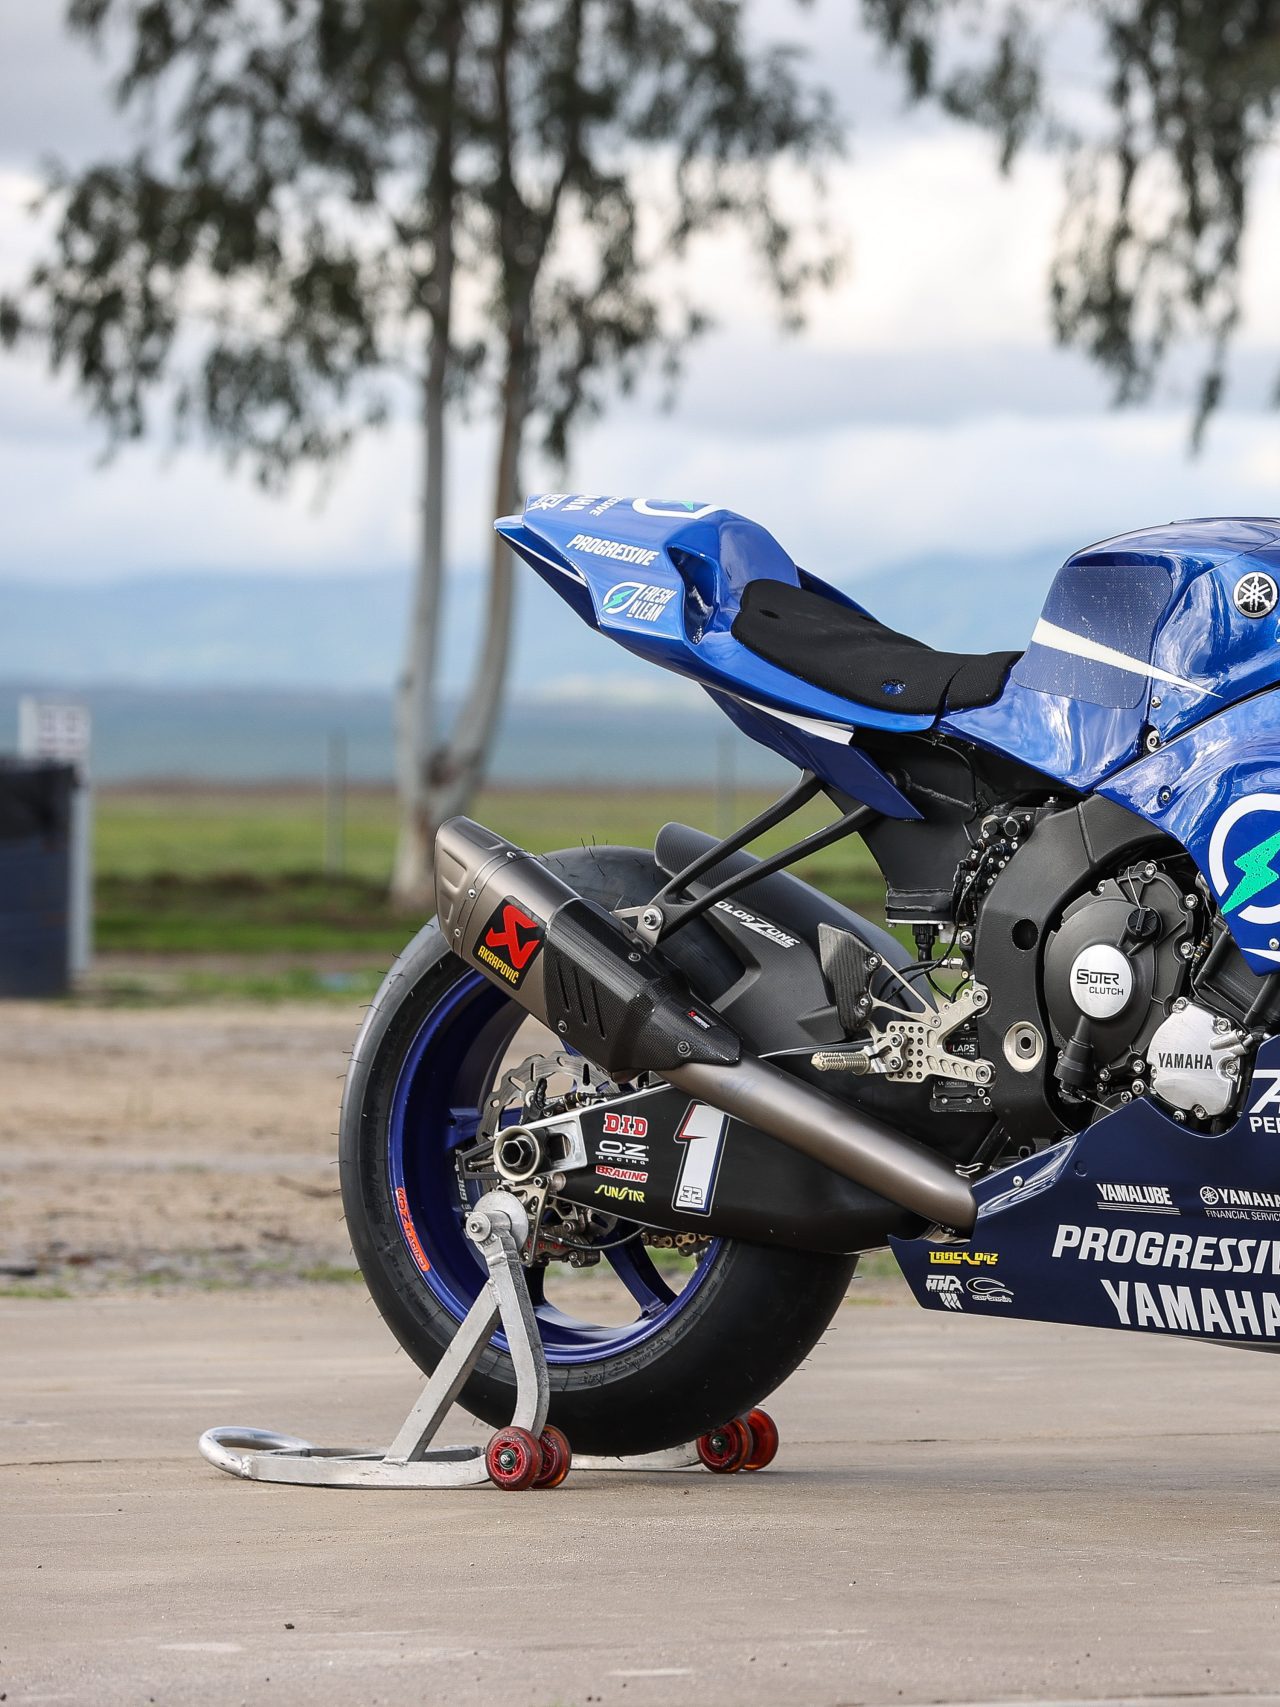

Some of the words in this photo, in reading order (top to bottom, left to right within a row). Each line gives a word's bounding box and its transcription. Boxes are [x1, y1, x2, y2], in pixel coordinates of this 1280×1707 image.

[566, 534, 660, 567] PROGRESSIVE
[639, 584, 678, 605] FRESH
[635, 602, 666, 622] LEAN
[714, 900, 801, 947] OLORZONE
[1088, 985, 1125, 996] CLUTCH
[1158, 1052, 1214, 1071] YAMAHA
[598, 1155, 647, 1165] RACING
[676, 1102, 729, 1212] 1
[595, 1165, 649, 1183] BRAKING
[594, 1184, 646, 1204] SUNSTAR
[679, 1185, 704, 1206] 32
[1096, 1183, 1173, 1205] YAMALUBE
[1205, 1209, 1251, 1220] FINANCIAL
